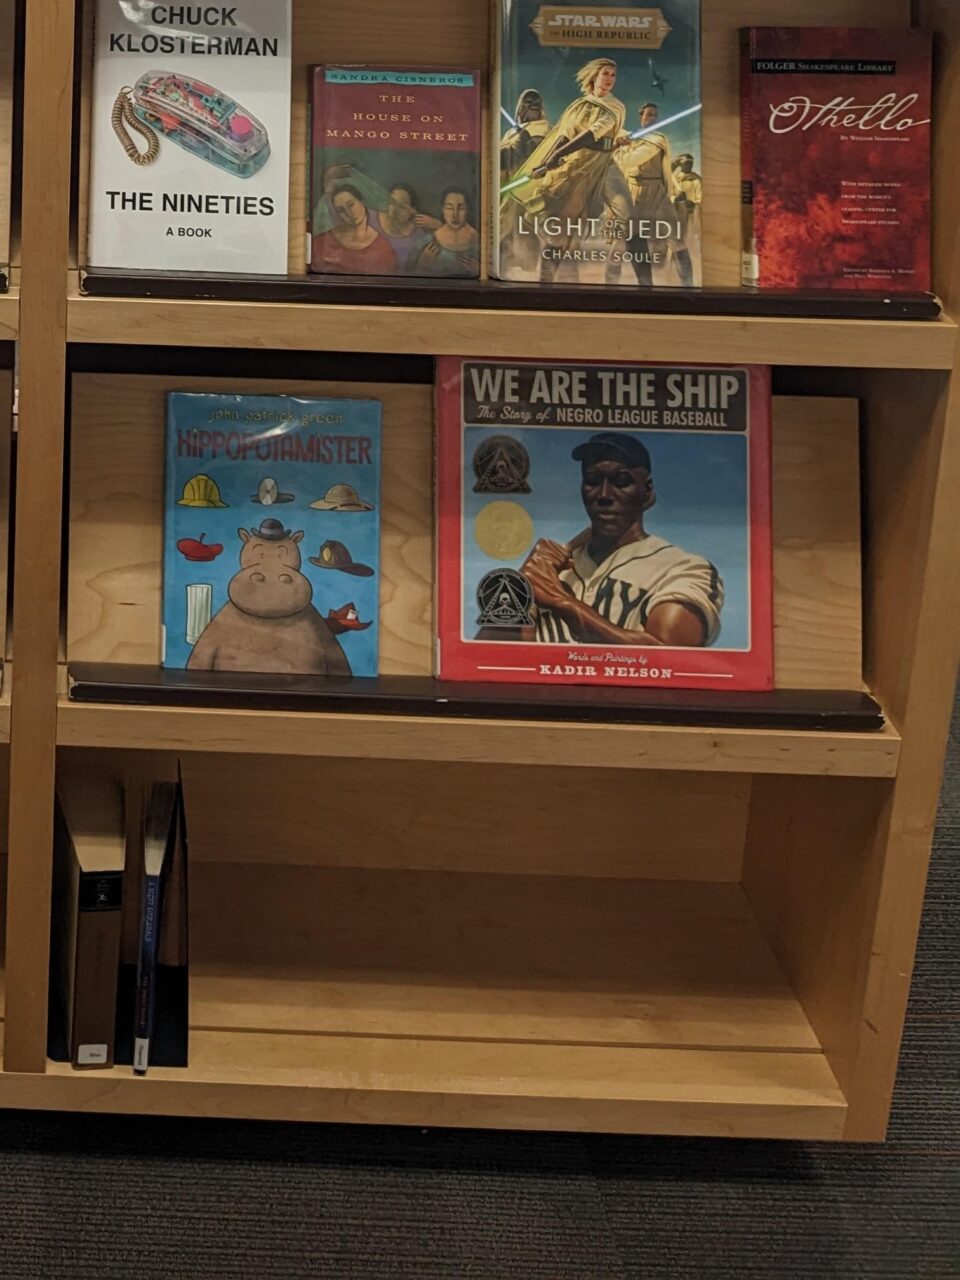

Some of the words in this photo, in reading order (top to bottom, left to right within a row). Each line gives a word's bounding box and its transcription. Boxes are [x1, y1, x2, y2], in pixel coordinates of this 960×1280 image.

[151, 6, 237, 26] CHUCK
[110, 34, 278, 56] KLOSTERMAN
[379, 95, 415, 103] THE
[354, 113, 410, 122] HOUSE
[421, 115, 444, 123] ON
[769, 93, 931, 134] Othello
[327, 130, 390, 139] MANGO
[399, 132, 468, 142] STREET
[106, 191, 153, 211] THE
[162, 193, 274, 216] NINETIES
[518, 215, 600, 237] LIGHT
[626, 219, 681, 241] JEDI
[543, 249, 606, 262] CHARLES
[614, 251, 660, 264] SOULE
[471, 368, 519, 402] WE
[530, 370, 587, 404] ARE
[598, 372, 656, 407] THE
[667, 373, 739, 409] SHIP
[540, 664, 596, 676] KADIR
[604, 666, 672, 679] NELSON
